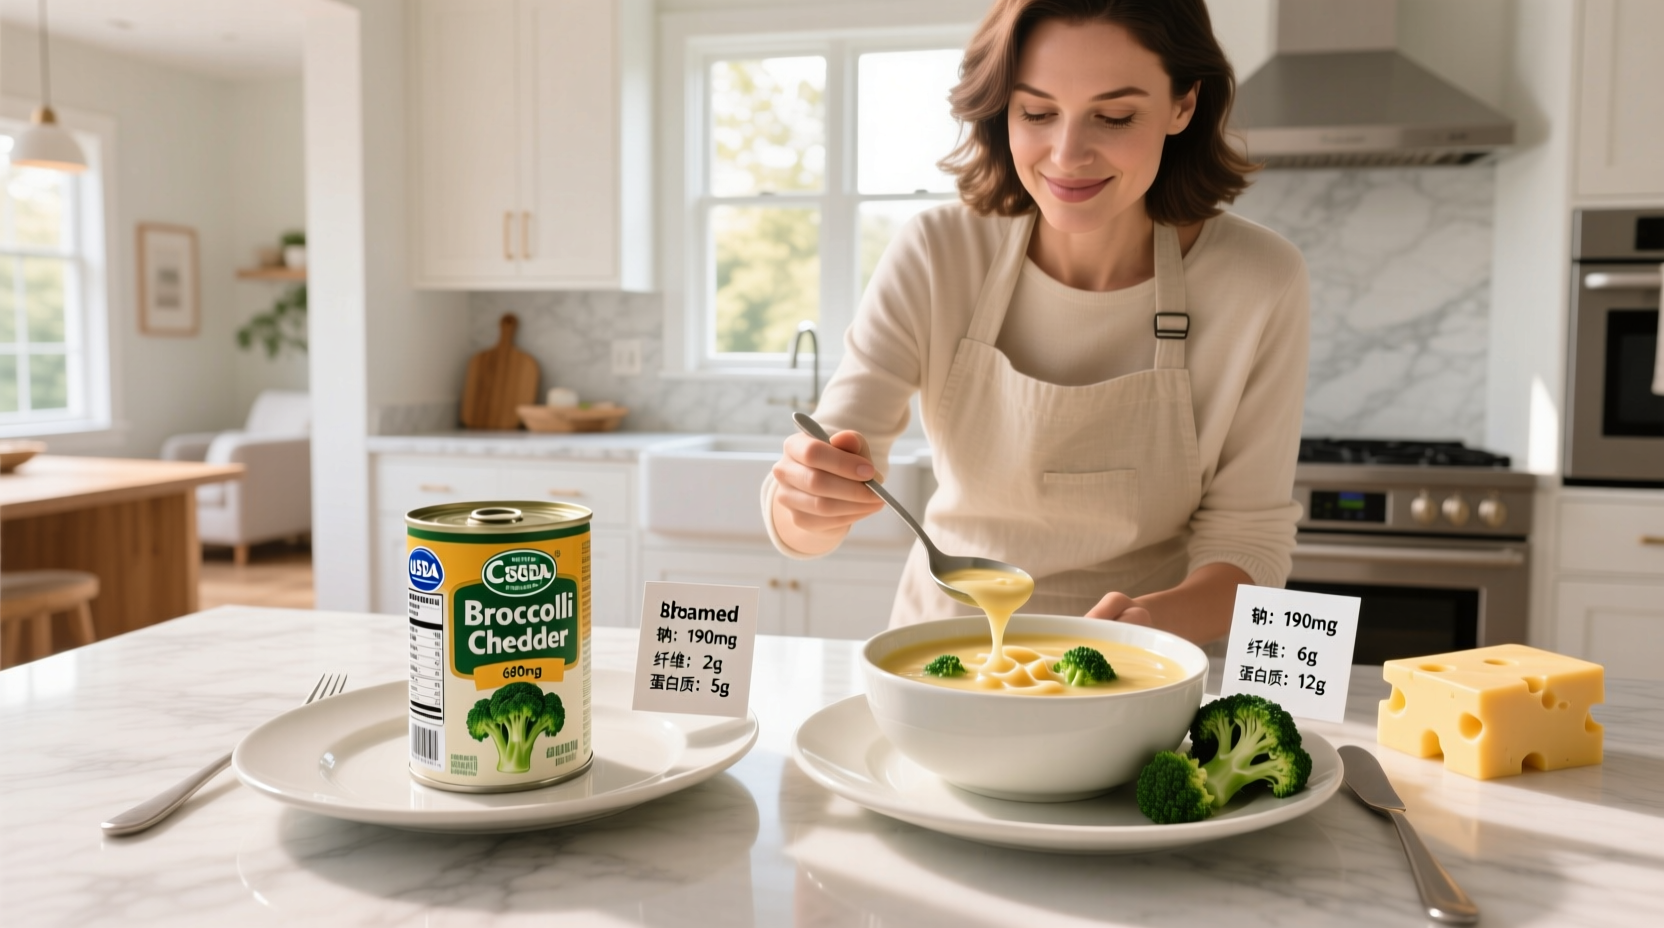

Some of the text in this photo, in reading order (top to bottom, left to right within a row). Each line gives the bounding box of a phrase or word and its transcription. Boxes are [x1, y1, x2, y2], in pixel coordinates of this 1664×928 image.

[410, 558, 440, 580] USDA
[464, 592, 573, 626] Broccolli
[1284, 611, 1338, 636] 190mg
[468, 626, 569, 655] Chedder
[687, 629, 737, 650] 190mg
[702, 655, 723, 674] 2g
[1297, 647, 1318, 667] 6g
[710, 678, 730, 698] 5g
[1298, 673, 1326, 696] 12g
